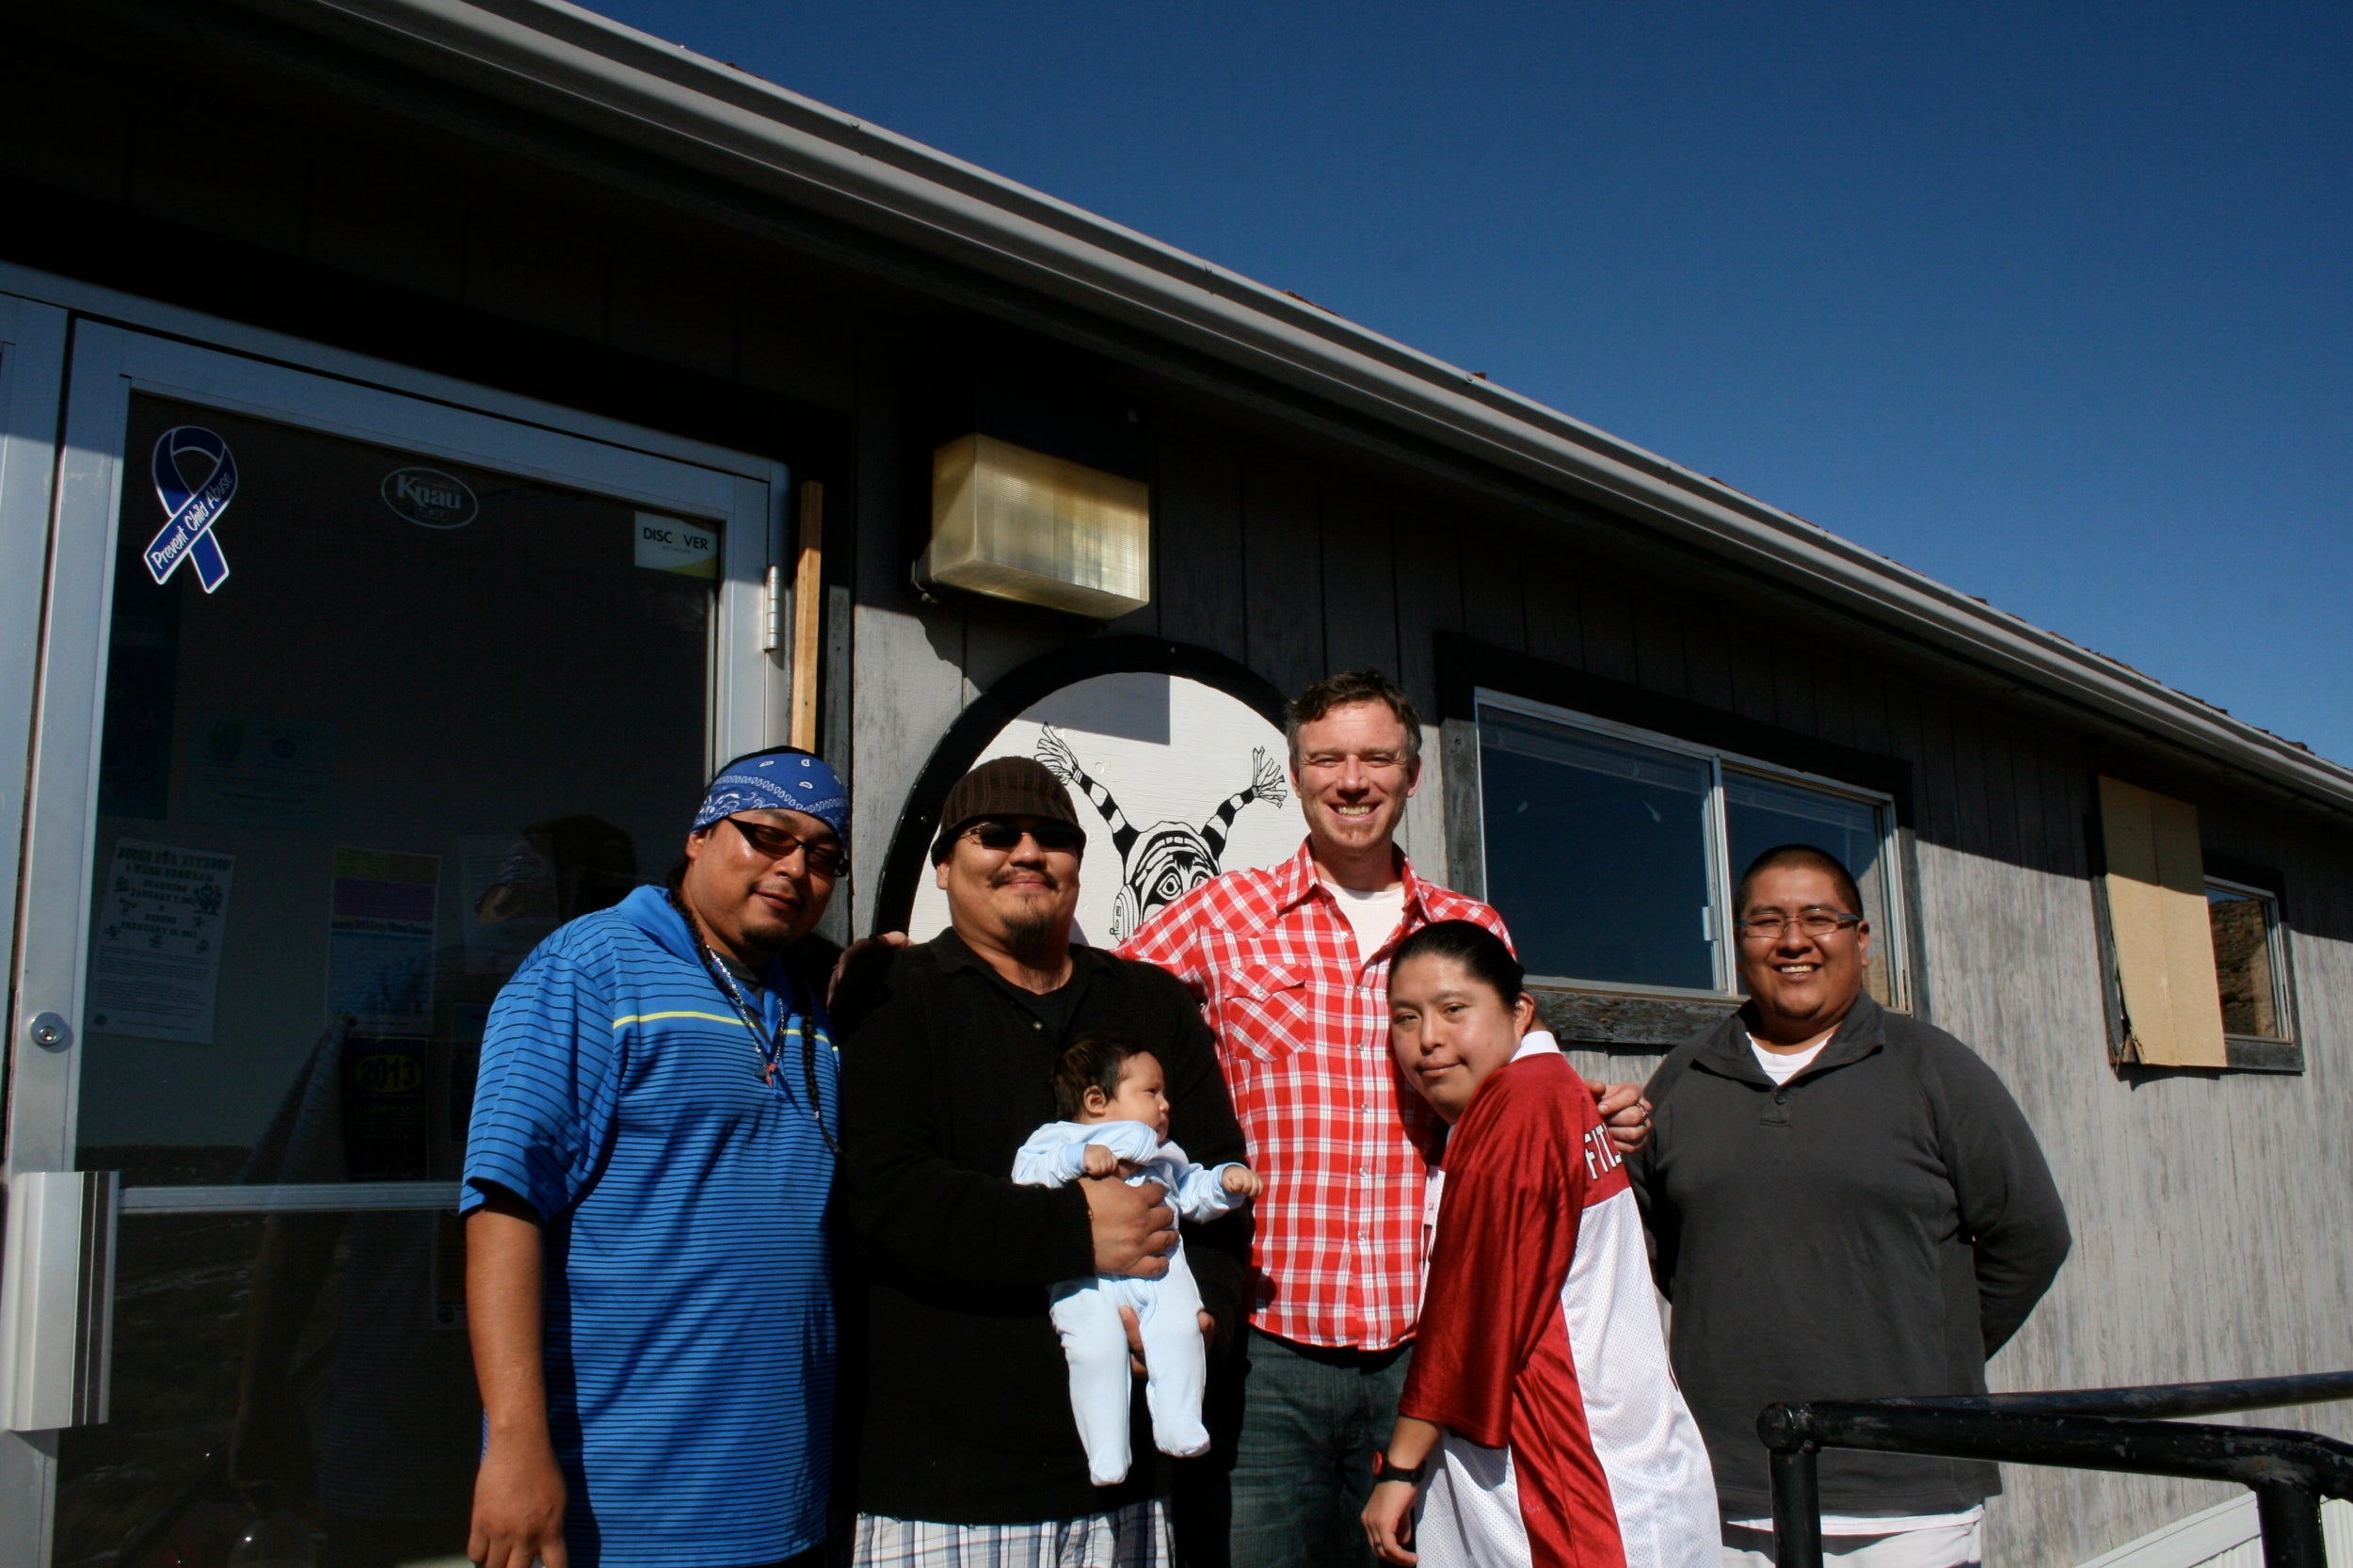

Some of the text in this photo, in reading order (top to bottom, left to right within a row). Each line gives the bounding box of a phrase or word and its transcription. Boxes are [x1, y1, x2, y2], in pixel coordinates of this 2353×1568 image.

[151, 472, 233, 569] Prevent Child Abuse
[361, 1057, 415, 1088] 2013
